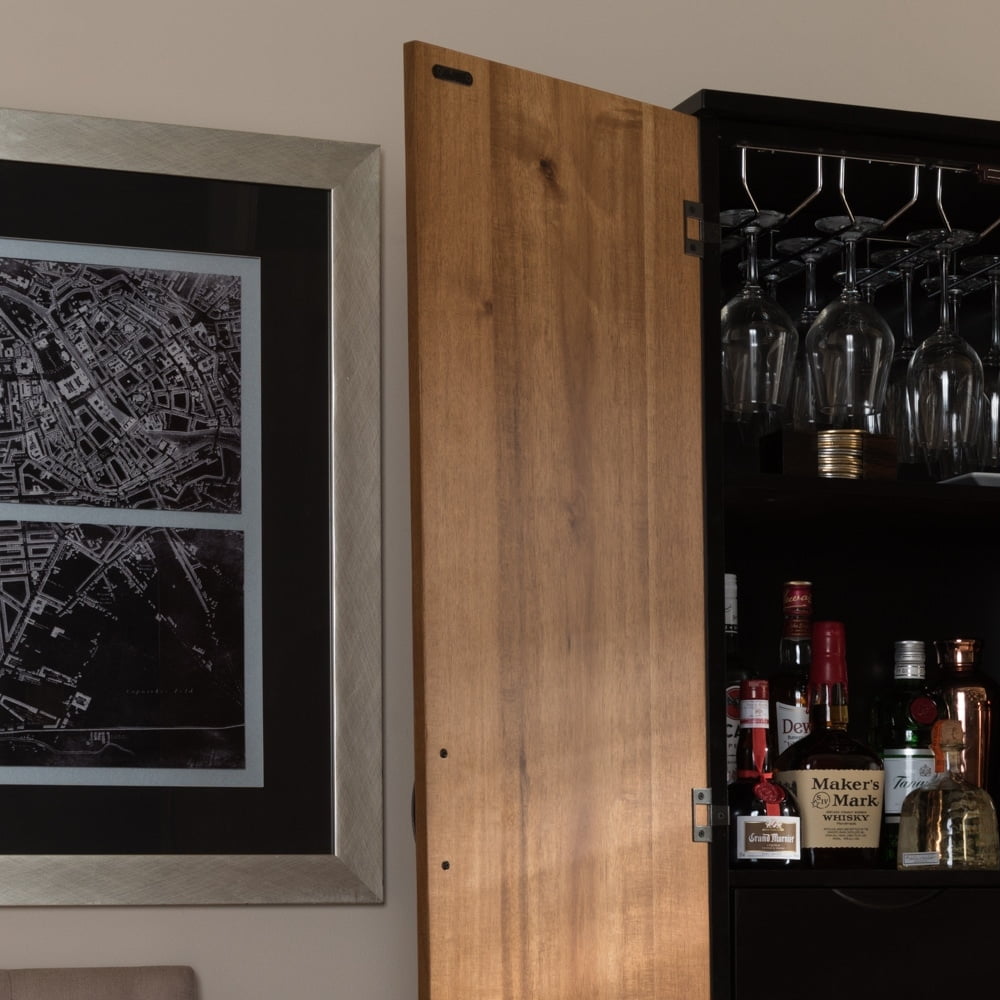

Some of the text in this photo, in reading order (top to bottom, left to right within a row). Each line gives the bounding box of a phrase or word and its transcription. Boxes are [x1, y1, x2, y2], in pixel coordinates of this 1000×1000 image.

[811, 777, 880, 791] Maker's
[832, 794, 880, 807] Mark
[823, 814, 870, 822] WHISKY
